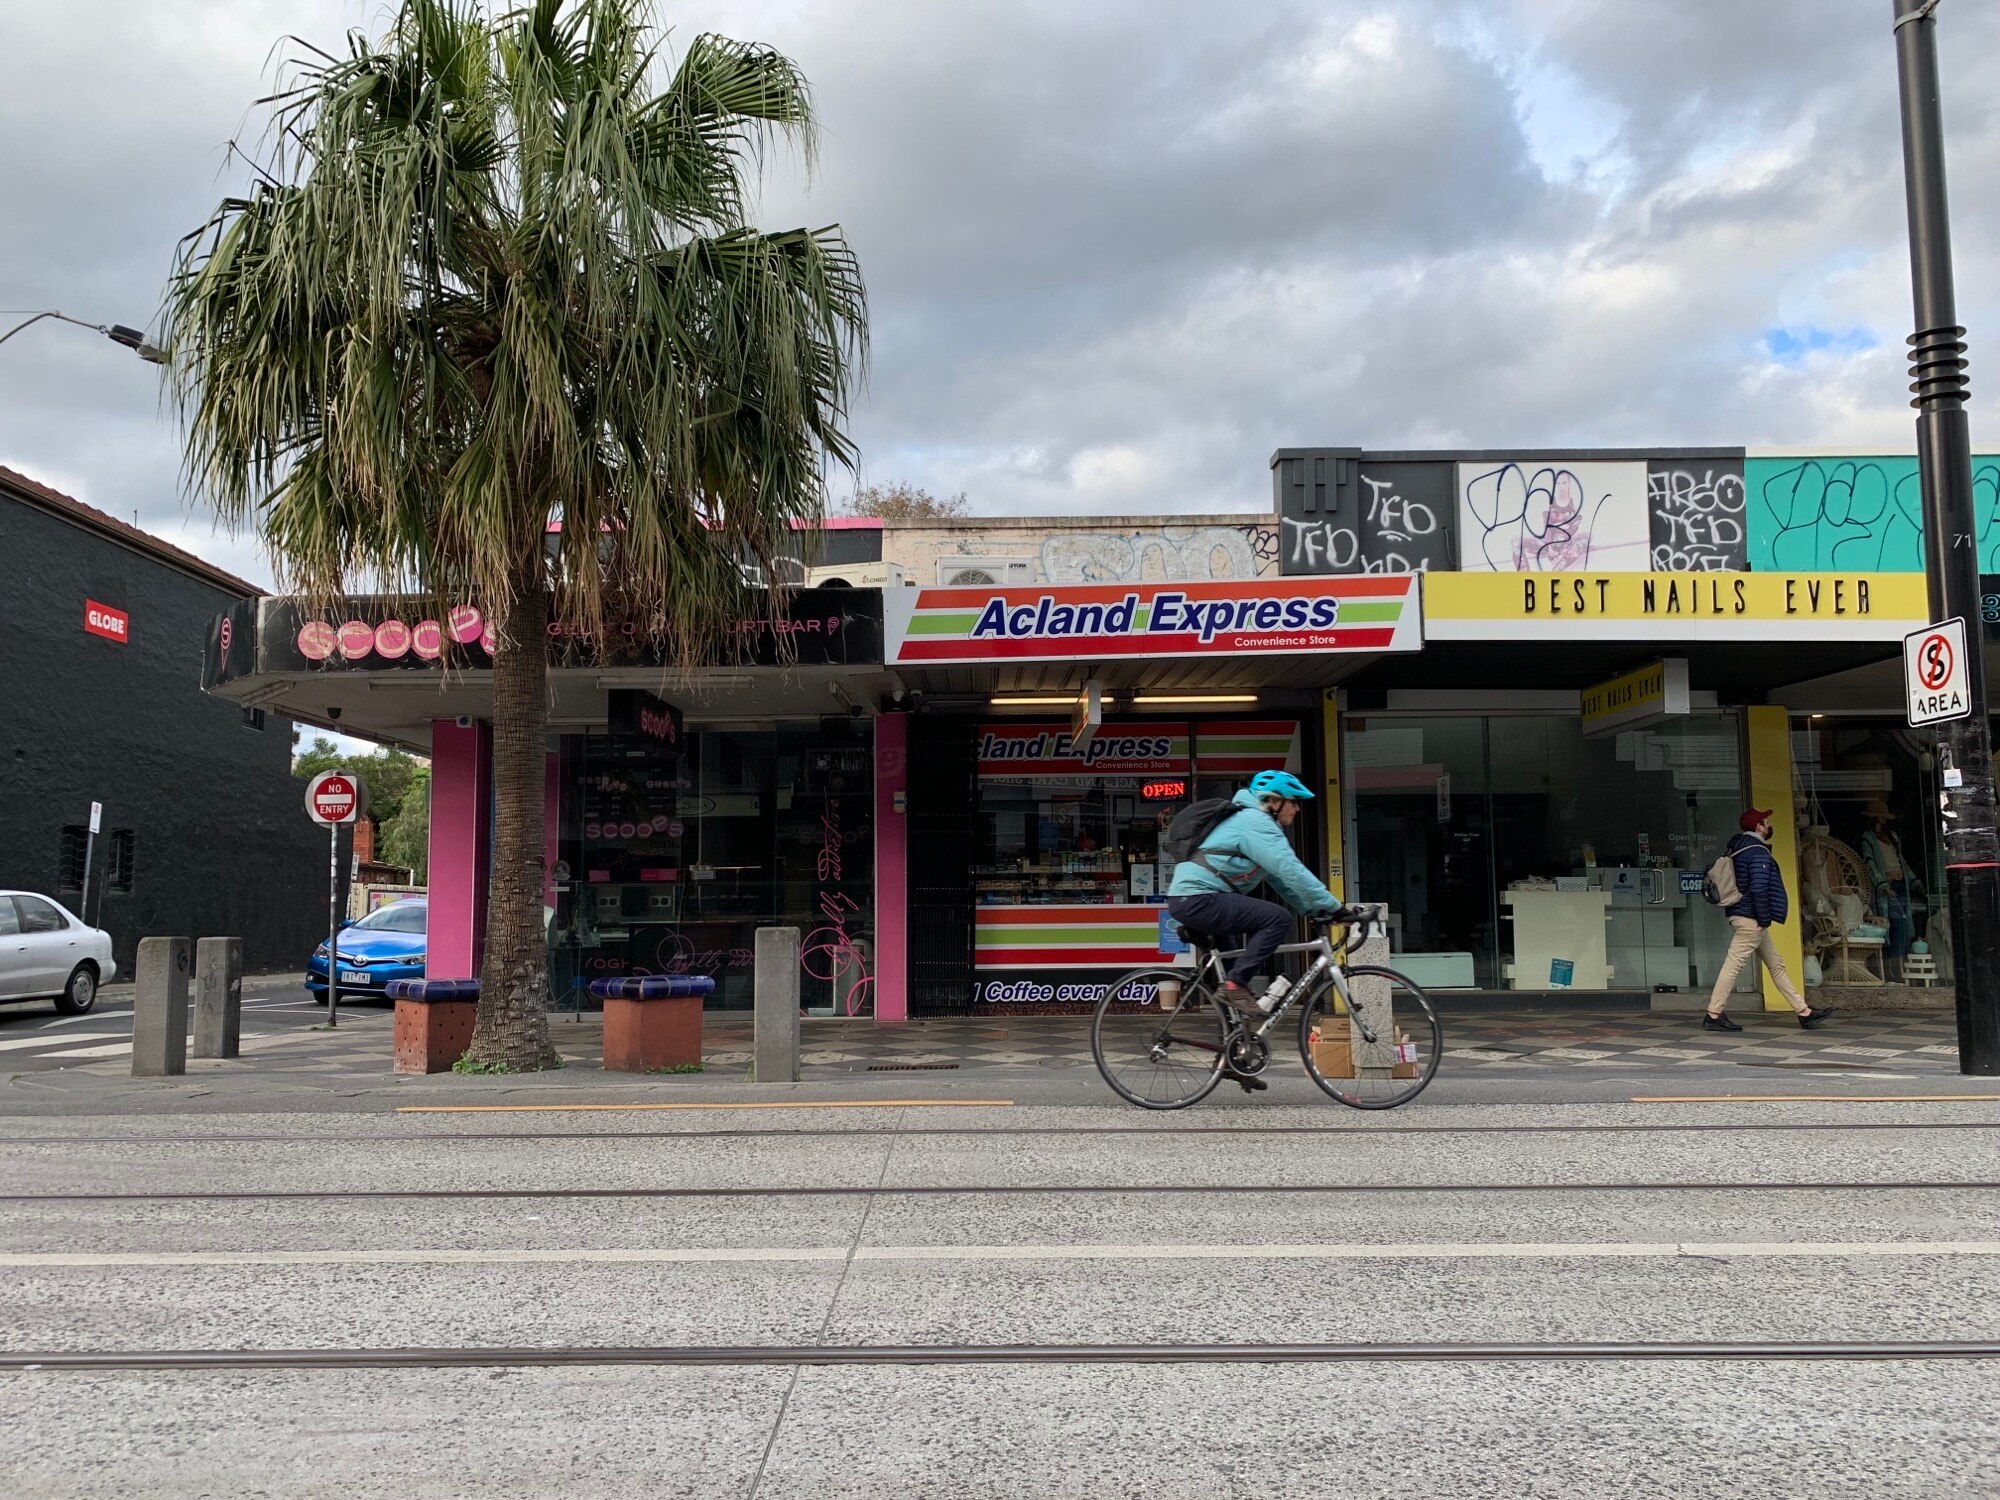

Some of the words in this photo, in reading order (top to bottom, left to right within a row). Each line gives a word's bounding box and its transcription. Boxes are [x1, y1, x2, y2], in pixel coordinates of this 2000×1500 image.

[1282, 516, 1359, 567] TFD
[1953, 533, 1971, 549] 71
[1524, 579, 1609, 613] BEST
[1643, 579, 1747, 613] NAILS
[1786, 579, 1870, 614] EVER
[88, 610, 125, 635] GLOBE
[775, 618, 821, 633] BAR
[972, 597, 1136, 637] Acland
[1146, 595, 1337, 643] Express
[1234, 636, 1306, 647] Convenience
[1309, 635, 1336, 645] Store
[1608, 684, 1632, 708] NAILS
[1639, 675, 1661, 698] EVER
[1917, 691, 1962, 715] AREA
[641, 707, 676, 744] SCOOPS
[1096, 761, 1149, 769] Convenience
[1150, 761, 1170, 769] Store
[328, 784, 342, 793] NO
[1143, 783, 1184, 797] OPEN
[320, 805, 349, 814] ENTRY
[586, 815, 684, 839] SCOOPS
[1645, 855, 1668, 863] PUSH
[985, 980, 1054, 1002] Coffee
[1117, 981, 1158, 1005] day
